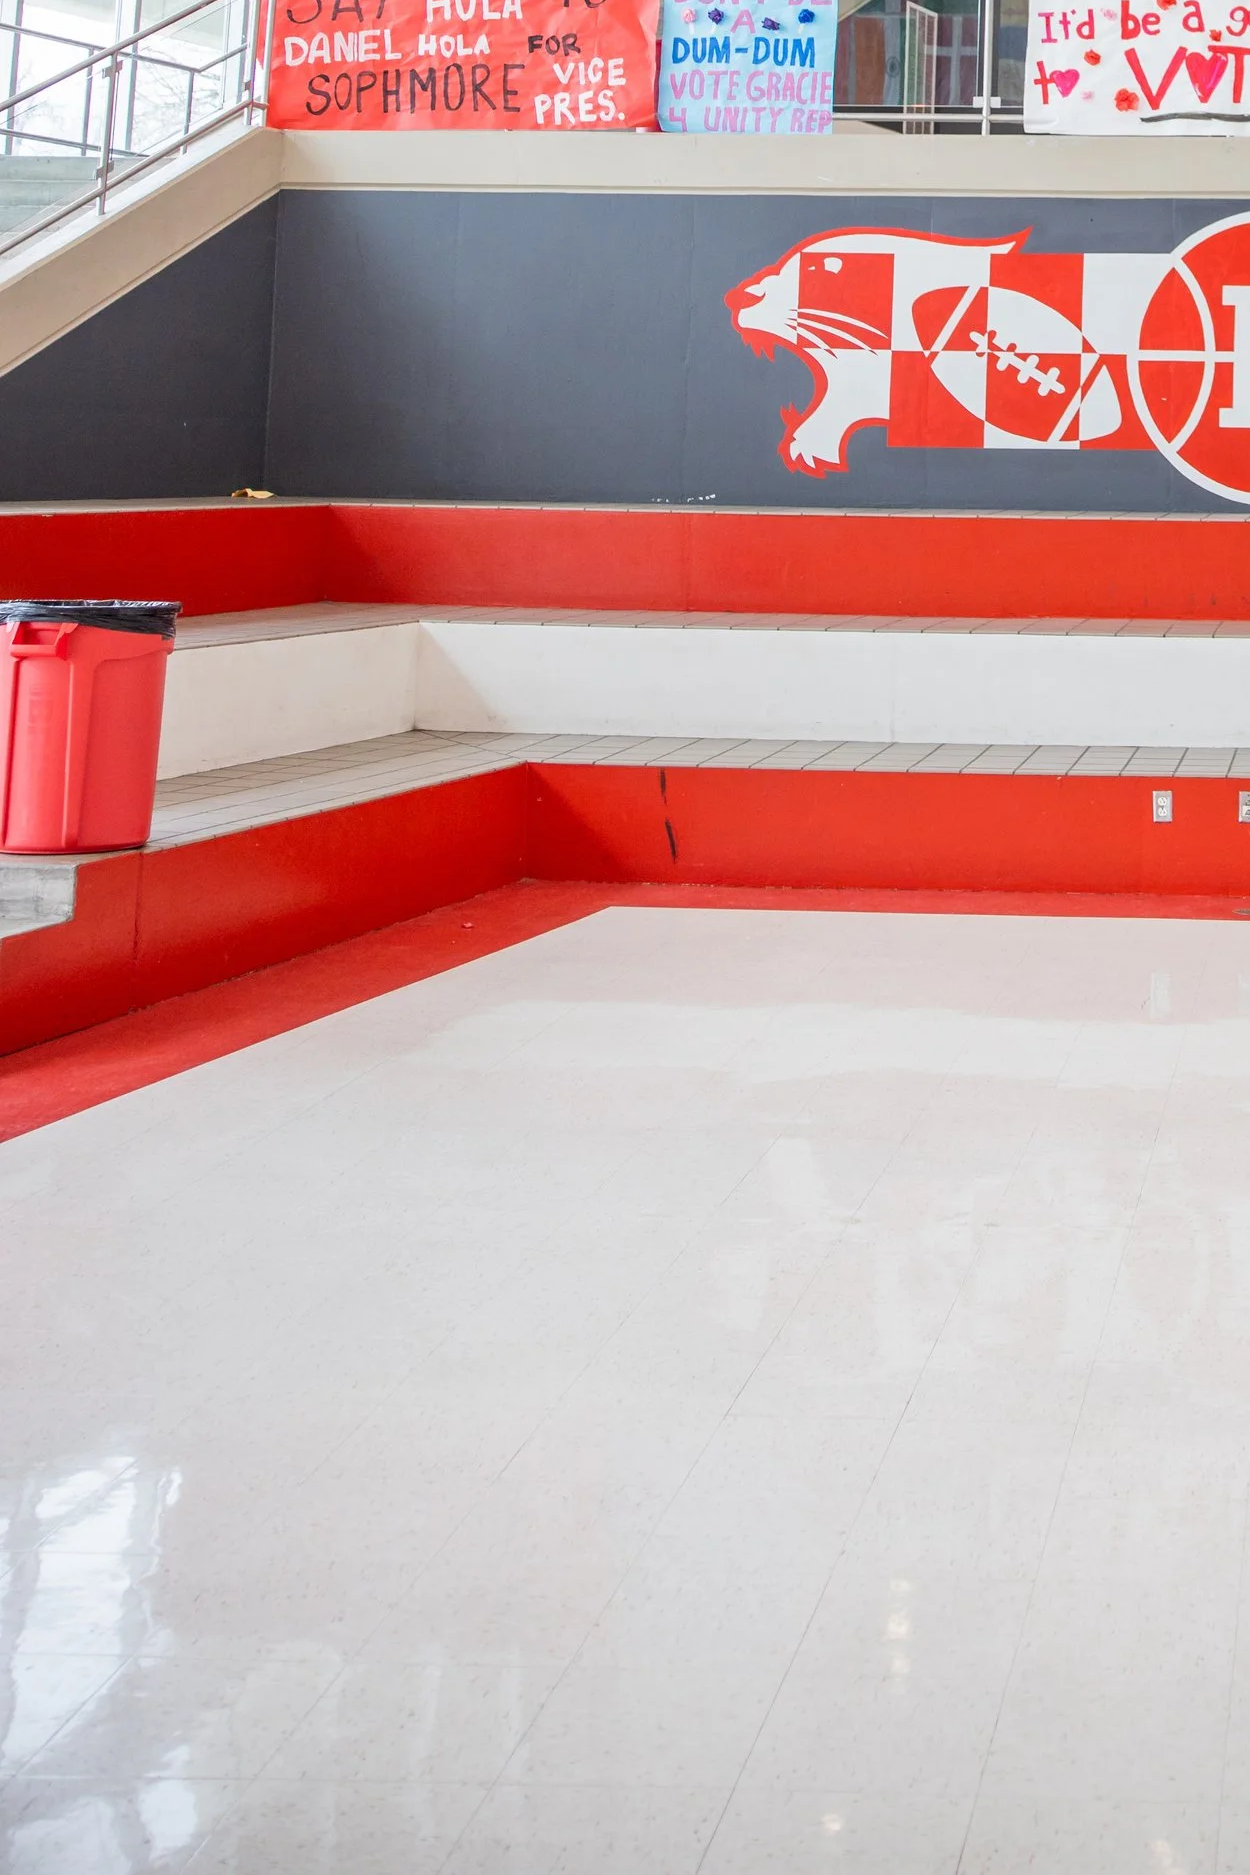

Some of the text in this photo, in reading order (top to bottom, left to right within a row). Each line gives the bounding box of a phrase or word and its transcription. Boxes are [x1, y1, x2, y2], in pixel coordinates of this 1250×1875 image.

[730, 9, 756, 34] A
[1120, 0, 1161, 40] be
[1182, 0, 1205, 33] a
[284, 29, 582, 67] DANIEL HOLA FOR
[672, 36, 816, 68] DUM-DUM
[306, 57, 627, 116] SOPHMORE VICE
[668, 69, 833, 105] VOTE GRACIE
[534, 89, 626, 125] PRES.
[668, 105, 833, 134] 4 UNITY REP
